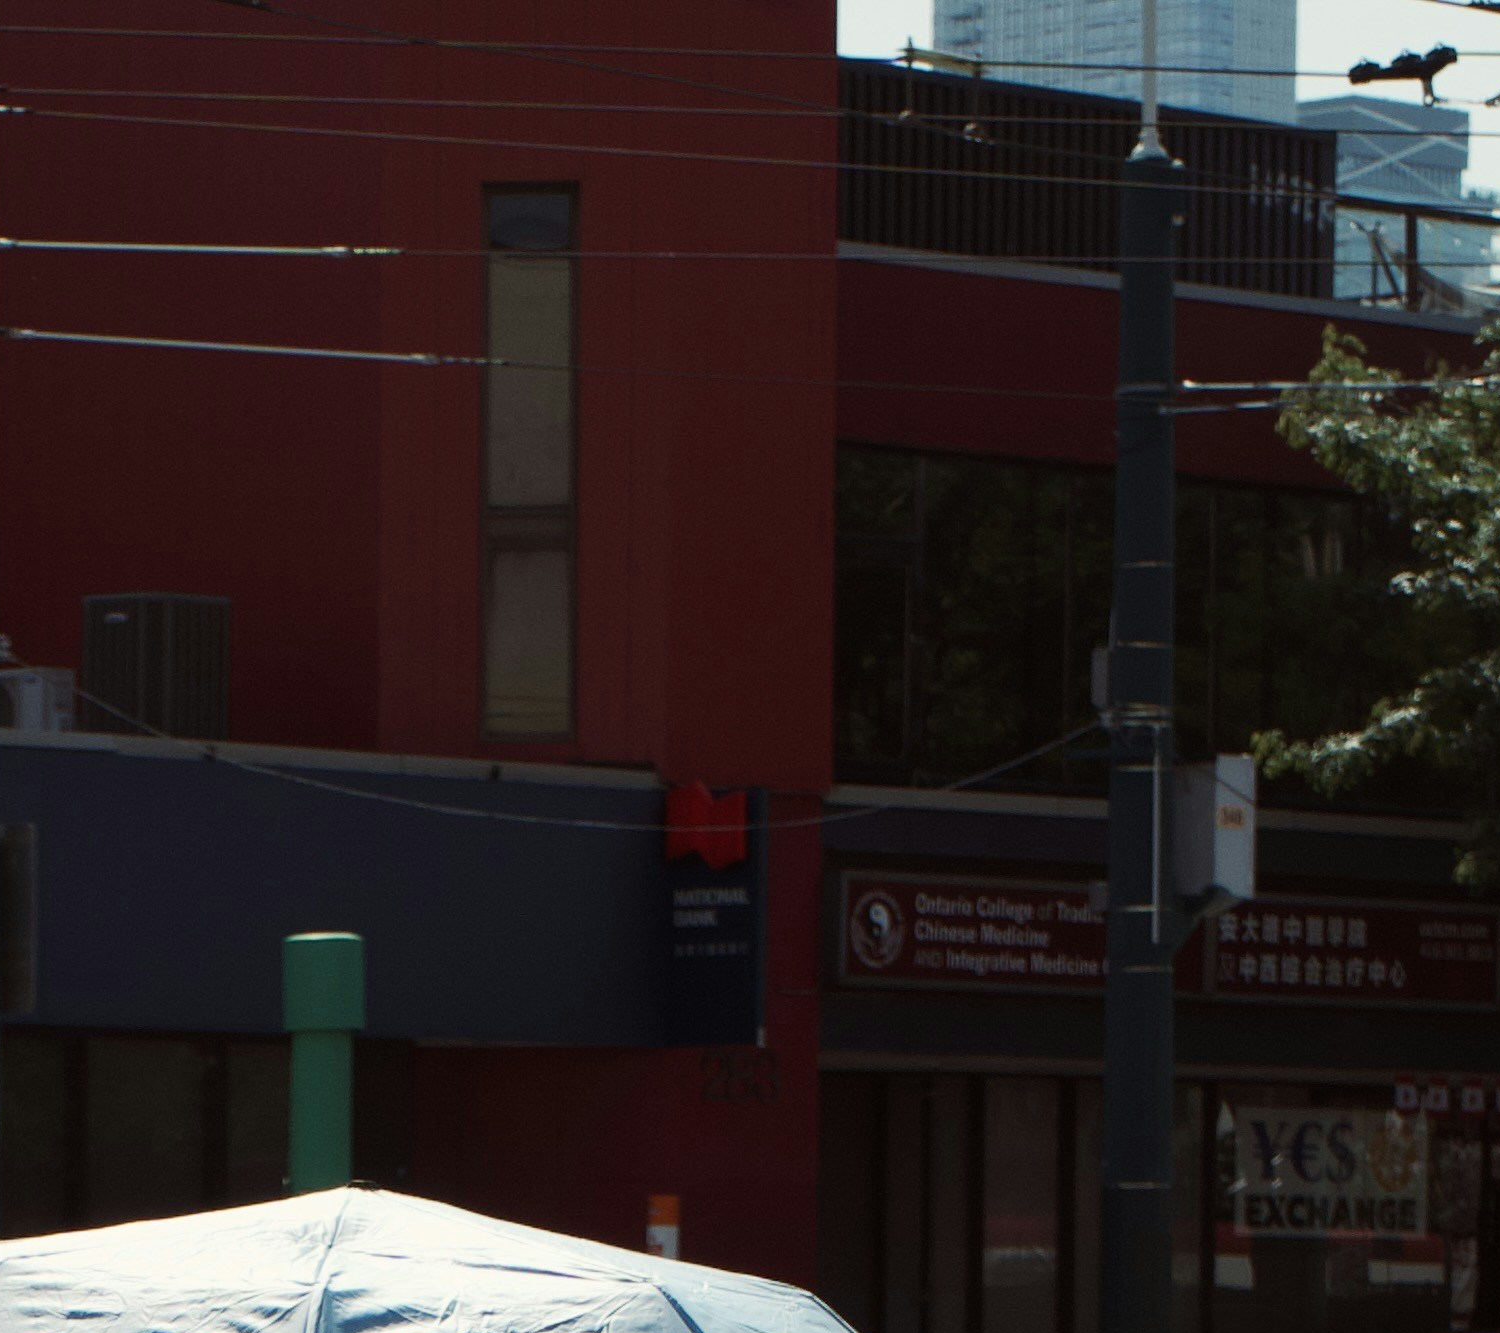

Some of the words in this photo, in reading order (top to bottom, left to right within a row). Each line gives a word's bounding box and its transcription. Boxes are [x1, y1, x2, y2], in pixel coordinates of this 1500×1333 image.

[915, 892, 973, 917] Ontario
[976, 895, 1033, 924] College
[914, 919, 978, 943] Chinese
[980, 922, 1049, 948] Medicine
[946, 949, 1028, 976] Integrative
[1030, 952, 1099, 976] Medicine
[1245, 1195, 1419, 1229] EXCHANGE
